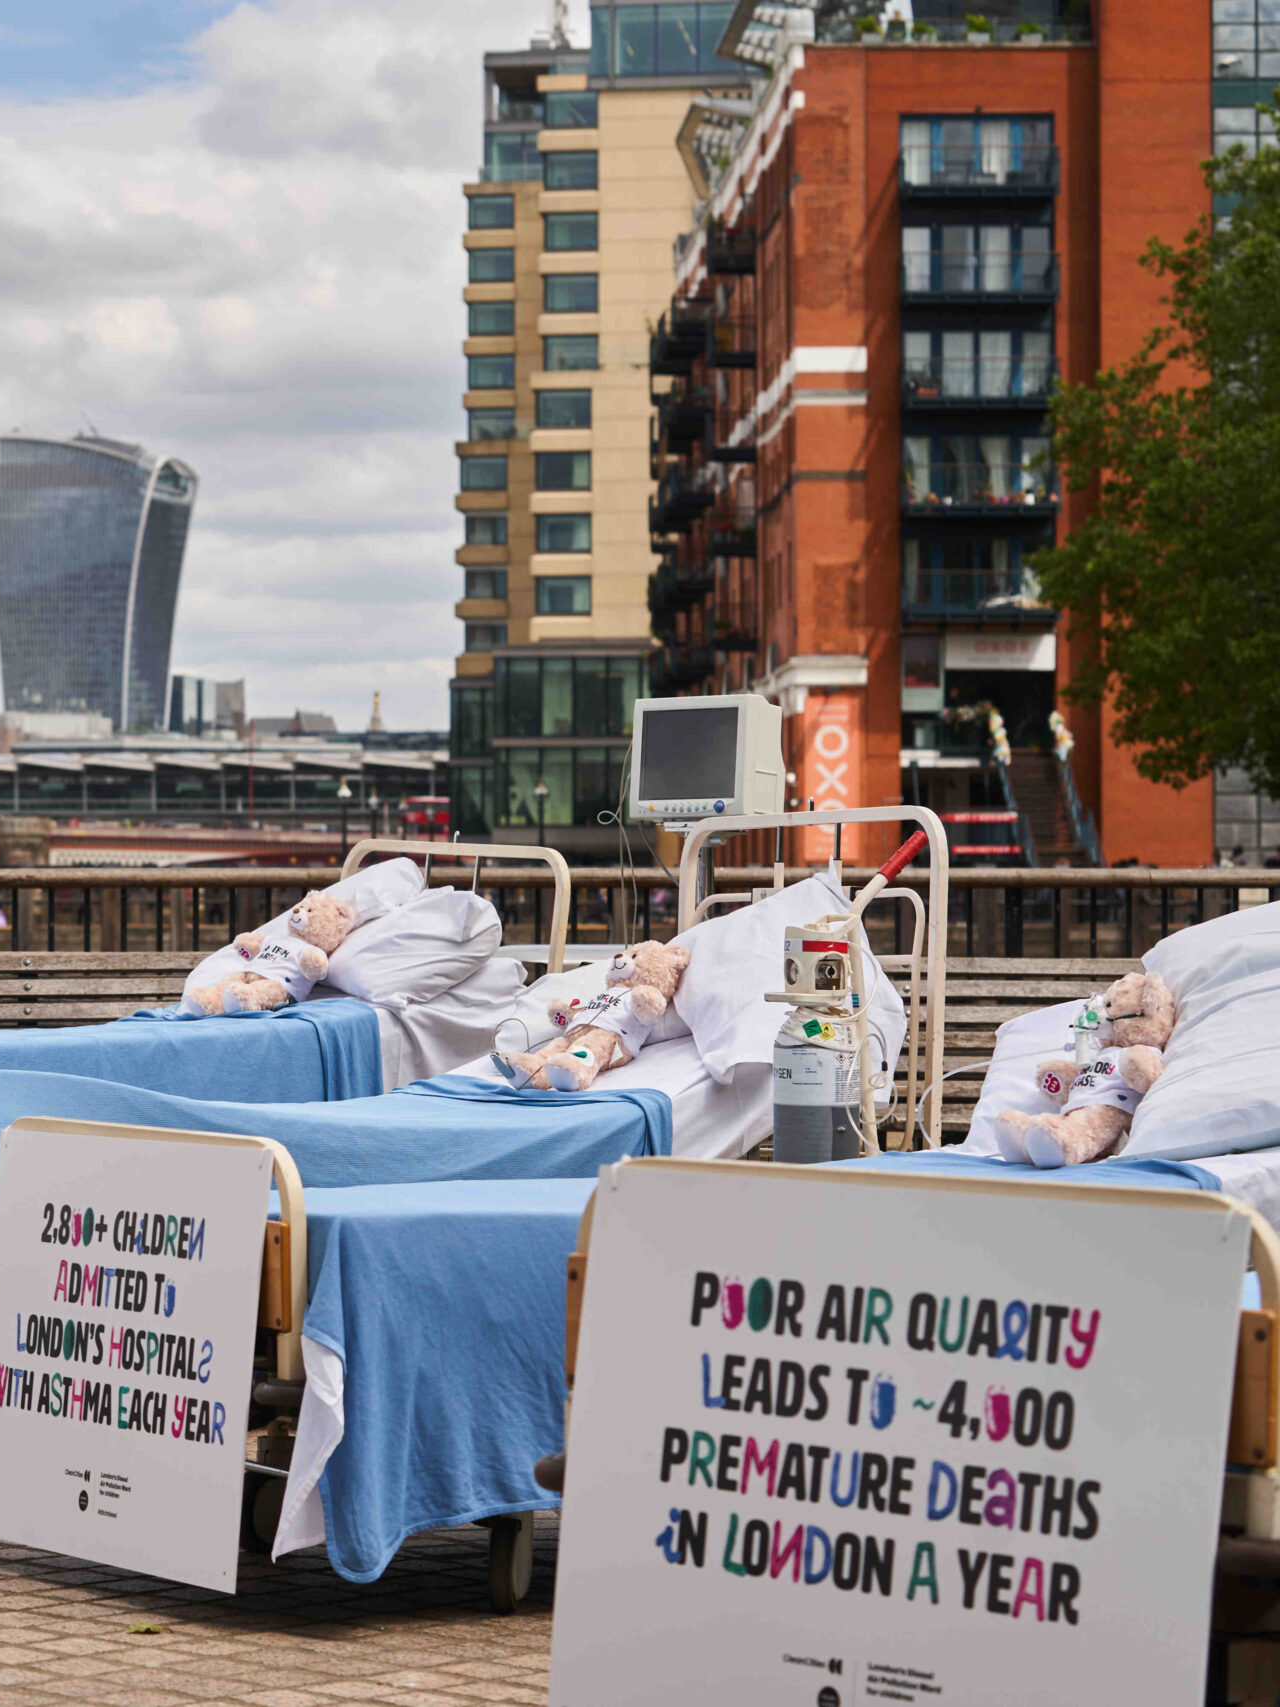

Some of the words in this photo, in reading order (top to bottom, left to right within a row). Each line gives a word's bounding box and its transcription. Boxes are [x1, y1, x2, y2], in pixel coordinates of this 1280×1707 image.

[814, 724, 850, 835] OXO
[41, 1202, 108, 1247] 2,800+
[53, 1259, 148, 1313] ADMITTED
[154, 1272, 177, 1318] TO
[691, 1271, 805, 1338] POOR
[816, 1283, 893, 1346] AIR
[16, 1312, 105, 1366] LONDON'S
[108, 1325, 213, 1384] HOSPITALS
[36, 1372, 112, 1426] ASTHMA
[117, 1386, 167, 1436] EACH
[702, 1352, 831, 1421] LEADS
[846, 1367, 897, 1431] TO
[660, 1426, 916, 1517] PREMATURE
[722, 1512, 895, 1598] LONDON
[906, 1541, 939, 1605] A
[958, 1547, 1081, 1626] YEAR
